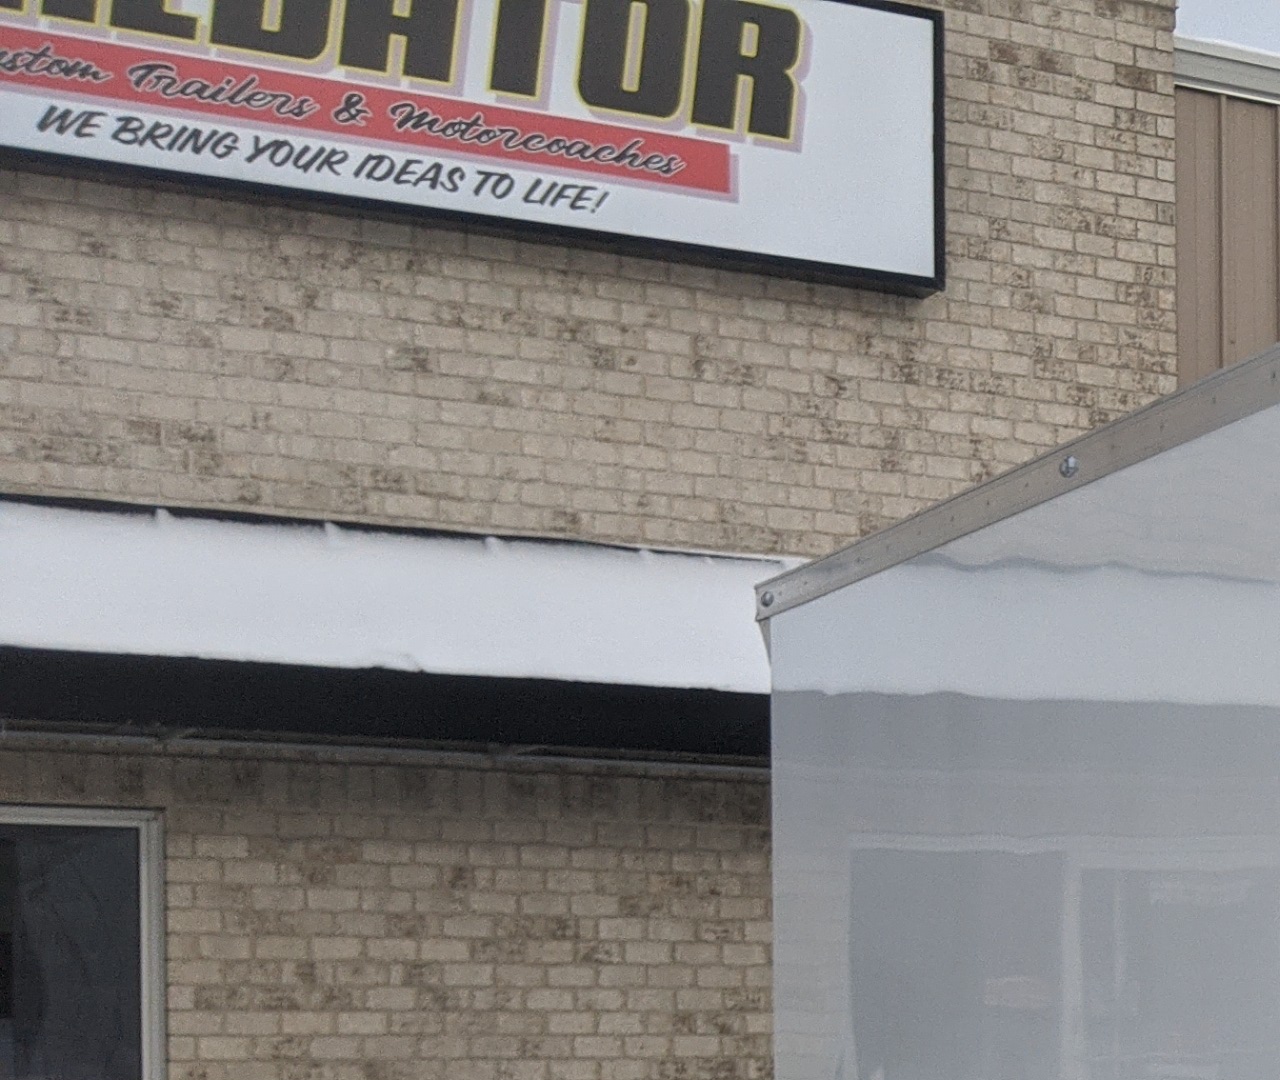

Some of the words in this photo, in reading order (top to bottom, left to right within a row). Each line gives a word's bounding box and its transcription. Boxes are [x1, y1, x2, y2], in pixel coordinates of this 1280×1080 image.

[0, 0, 802, 142] ATOR
[0, 46, 112, 82] stom
[129, 64, 317, 118] Trailers
[334, 93, 371, 124] &
[390, 102, 684, 175] Motorcoaches
[37, 105, 107, 138] WE
[111, 116, 239, 158] BRING
[249, 135, 348, 176] YOUR
[353, 153, 466, 194] IDEAS
[474, 170, 515, 199] TO
[522, 178, 610, 214] LIFE!
